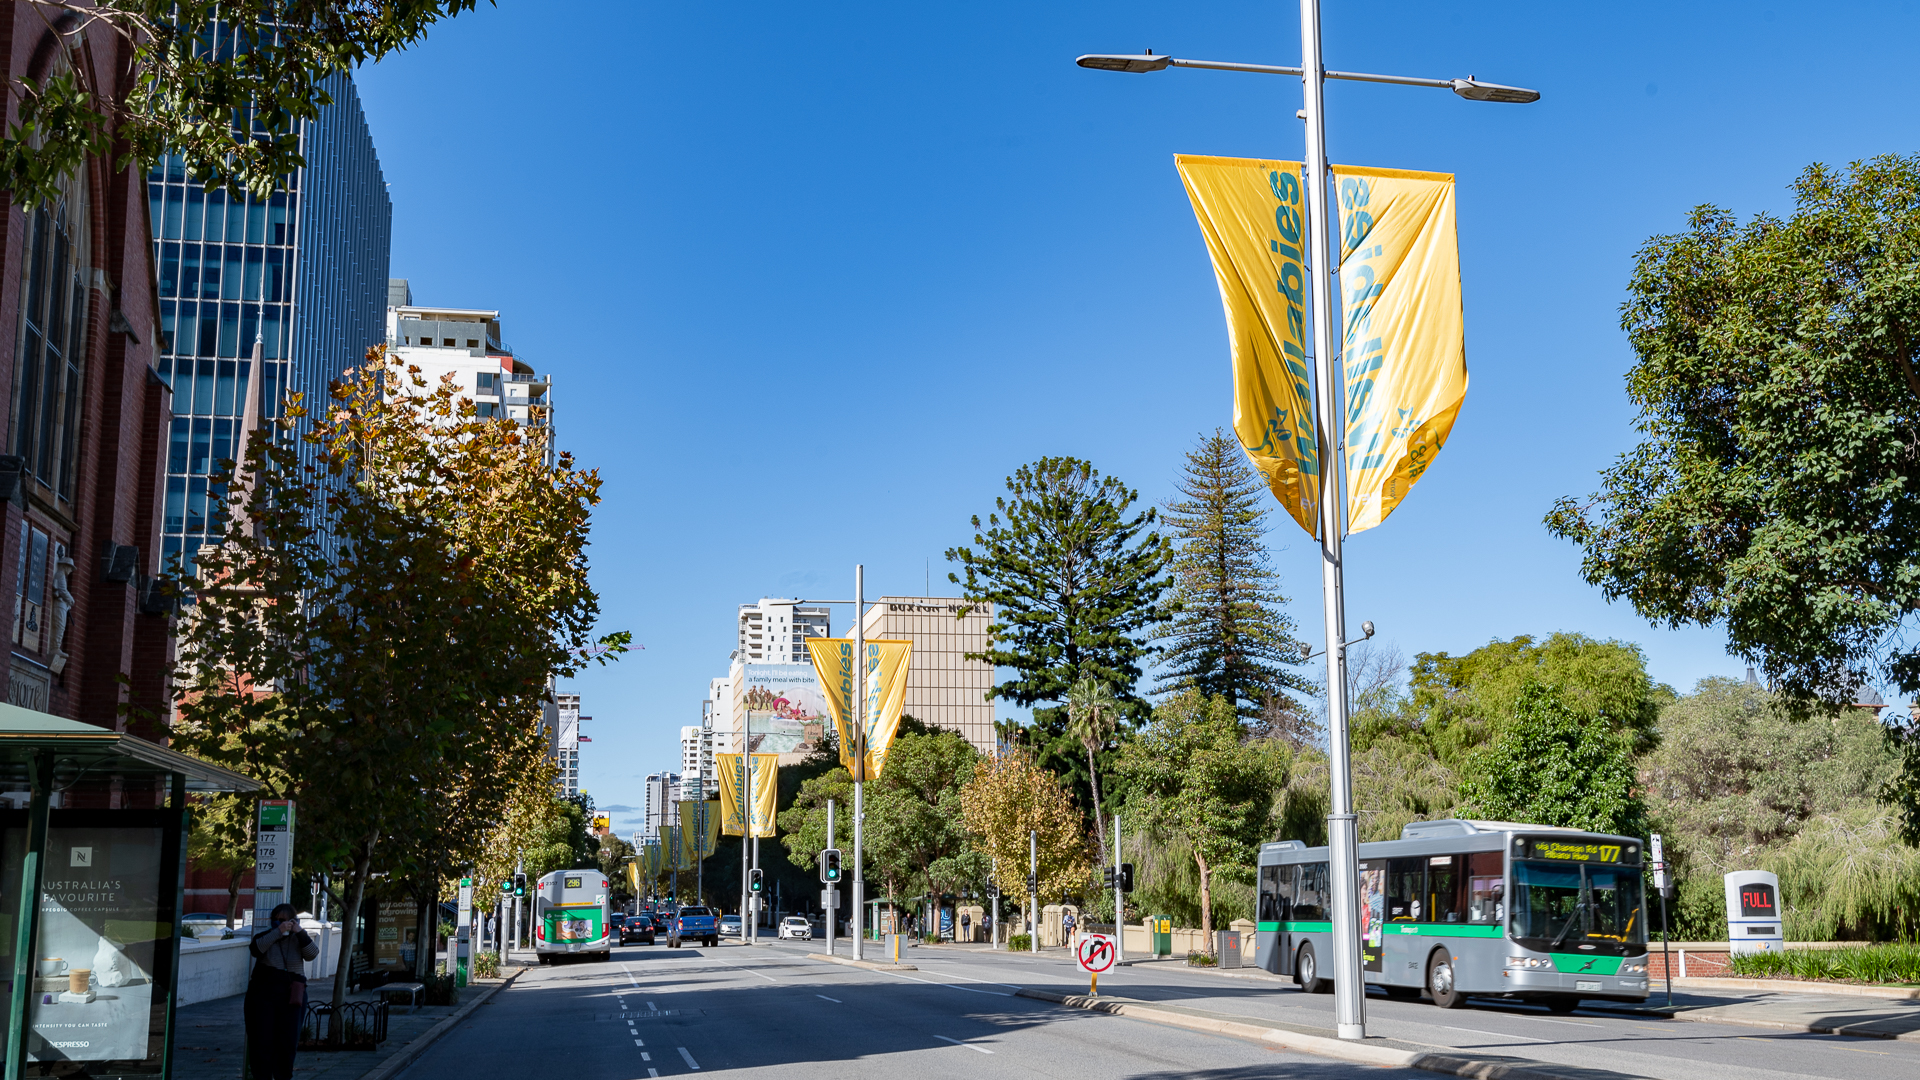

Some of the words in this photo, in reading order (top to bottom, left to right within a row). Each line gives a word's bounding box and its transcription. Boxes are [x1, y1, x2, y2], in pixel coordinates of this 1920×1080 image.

[1269, 170, 1319, 477] Wallabies
[748, 669, 771, 677] Tonight,
[788, 670, 808, 678] eating
[753, 676, 771, 684] family
[839, 642, 855, 758] Wallabies
[734, 756, 744, 824] Wallabies
[280, 813, 287, 822] A
[260, 834, 276, 842] 177
[260, 848, 275, 856] 178
[258, 862, 275, 870] 179
[567, 879, 580, 887] 296
[43, 893, 115, 902] FAVOURITE
[1743, 892, 1772, 908] FULL
[379, 908, 417, 916] regrowing
[48, 1040, 90, 1048] NESPRESSO
